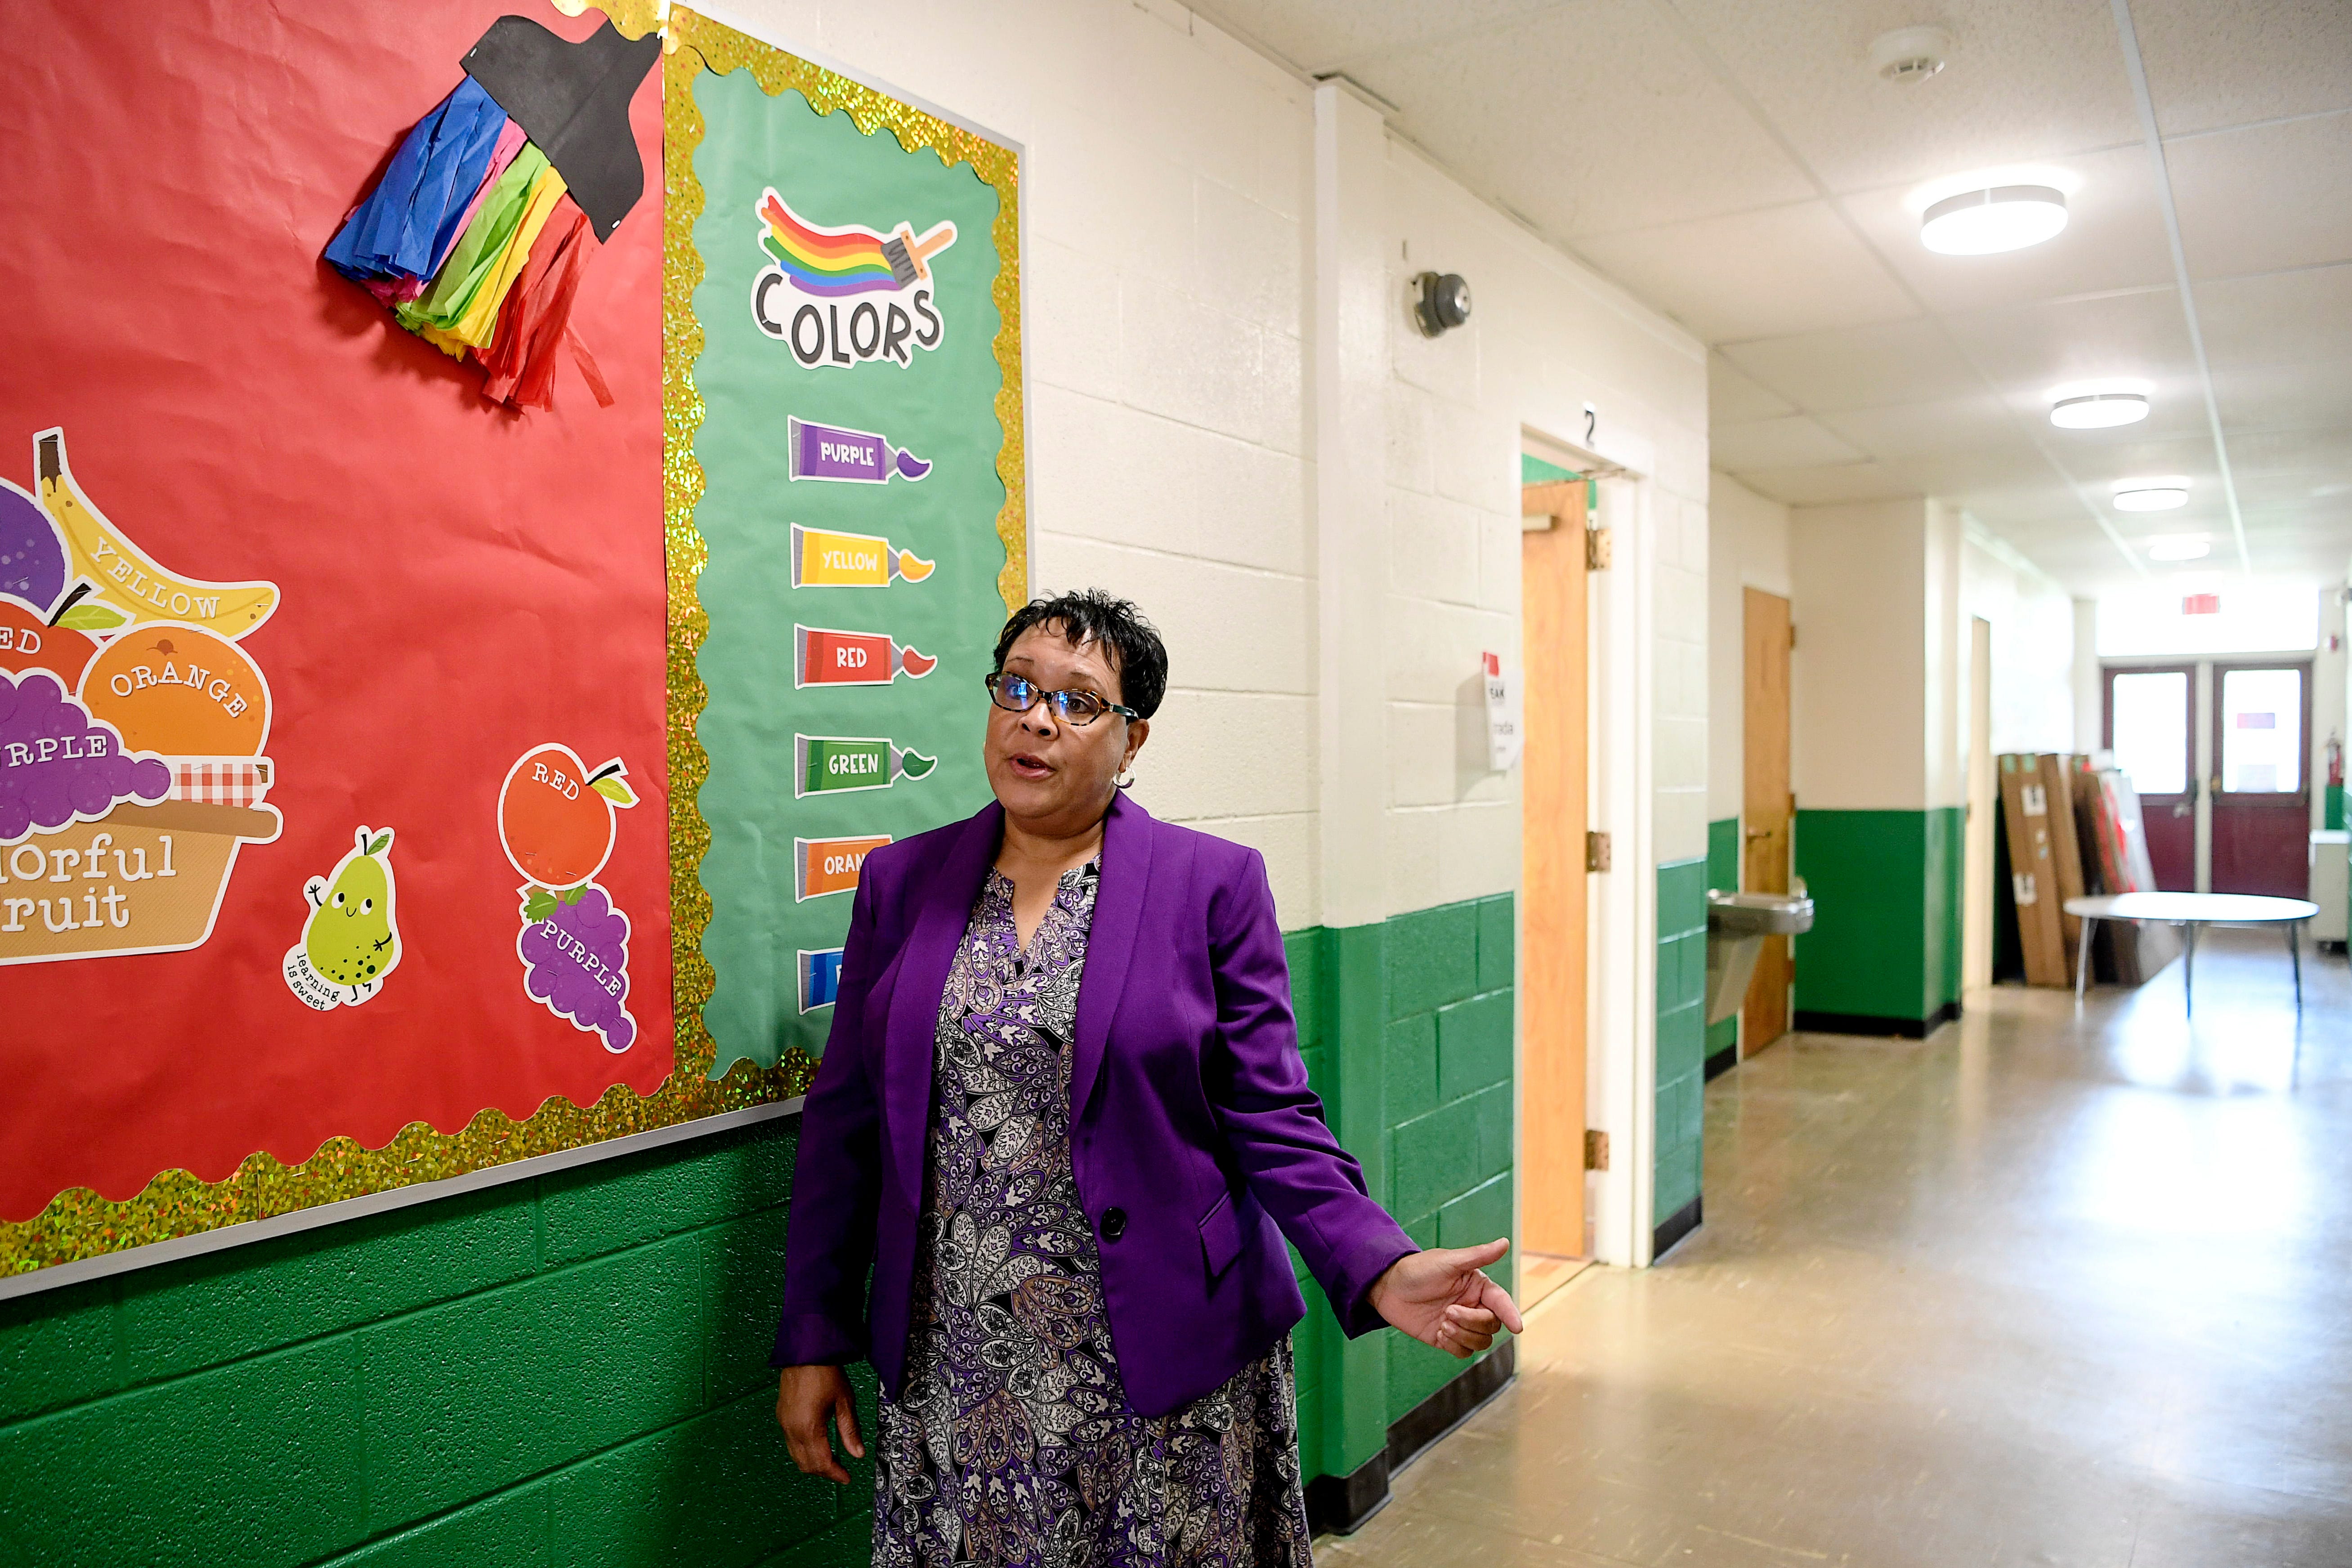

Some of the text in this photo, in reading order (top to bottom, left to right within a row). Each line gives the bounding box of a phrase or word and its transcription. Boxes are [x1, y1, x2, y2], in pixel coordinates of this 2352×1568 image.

[756, 273, 939, 364] COLORS
[820, 442, 875, 467] PURPLE
[90, 536, 220, 619] YELLOW
[822, 550, 878, 571] YELLOW
[0, 626, 41, 654] ED
[836, 647, 867, 668] RED
[111, 661, 247, 718] ORANGE
[0, 735, 107, 767] RPLE
[829, 754, 879, 775] GREEN
[532, 762, 580, 801] RED
[0, 833, 177, 884] orful
[824, 853, 866, 875] ORAN
[1, 885, 130, 933] ruit
[297, 953, 340, 1002] learning
[540, 919, 622, 997] PURPLE
[287, 965, 325, 1010] is sweet
